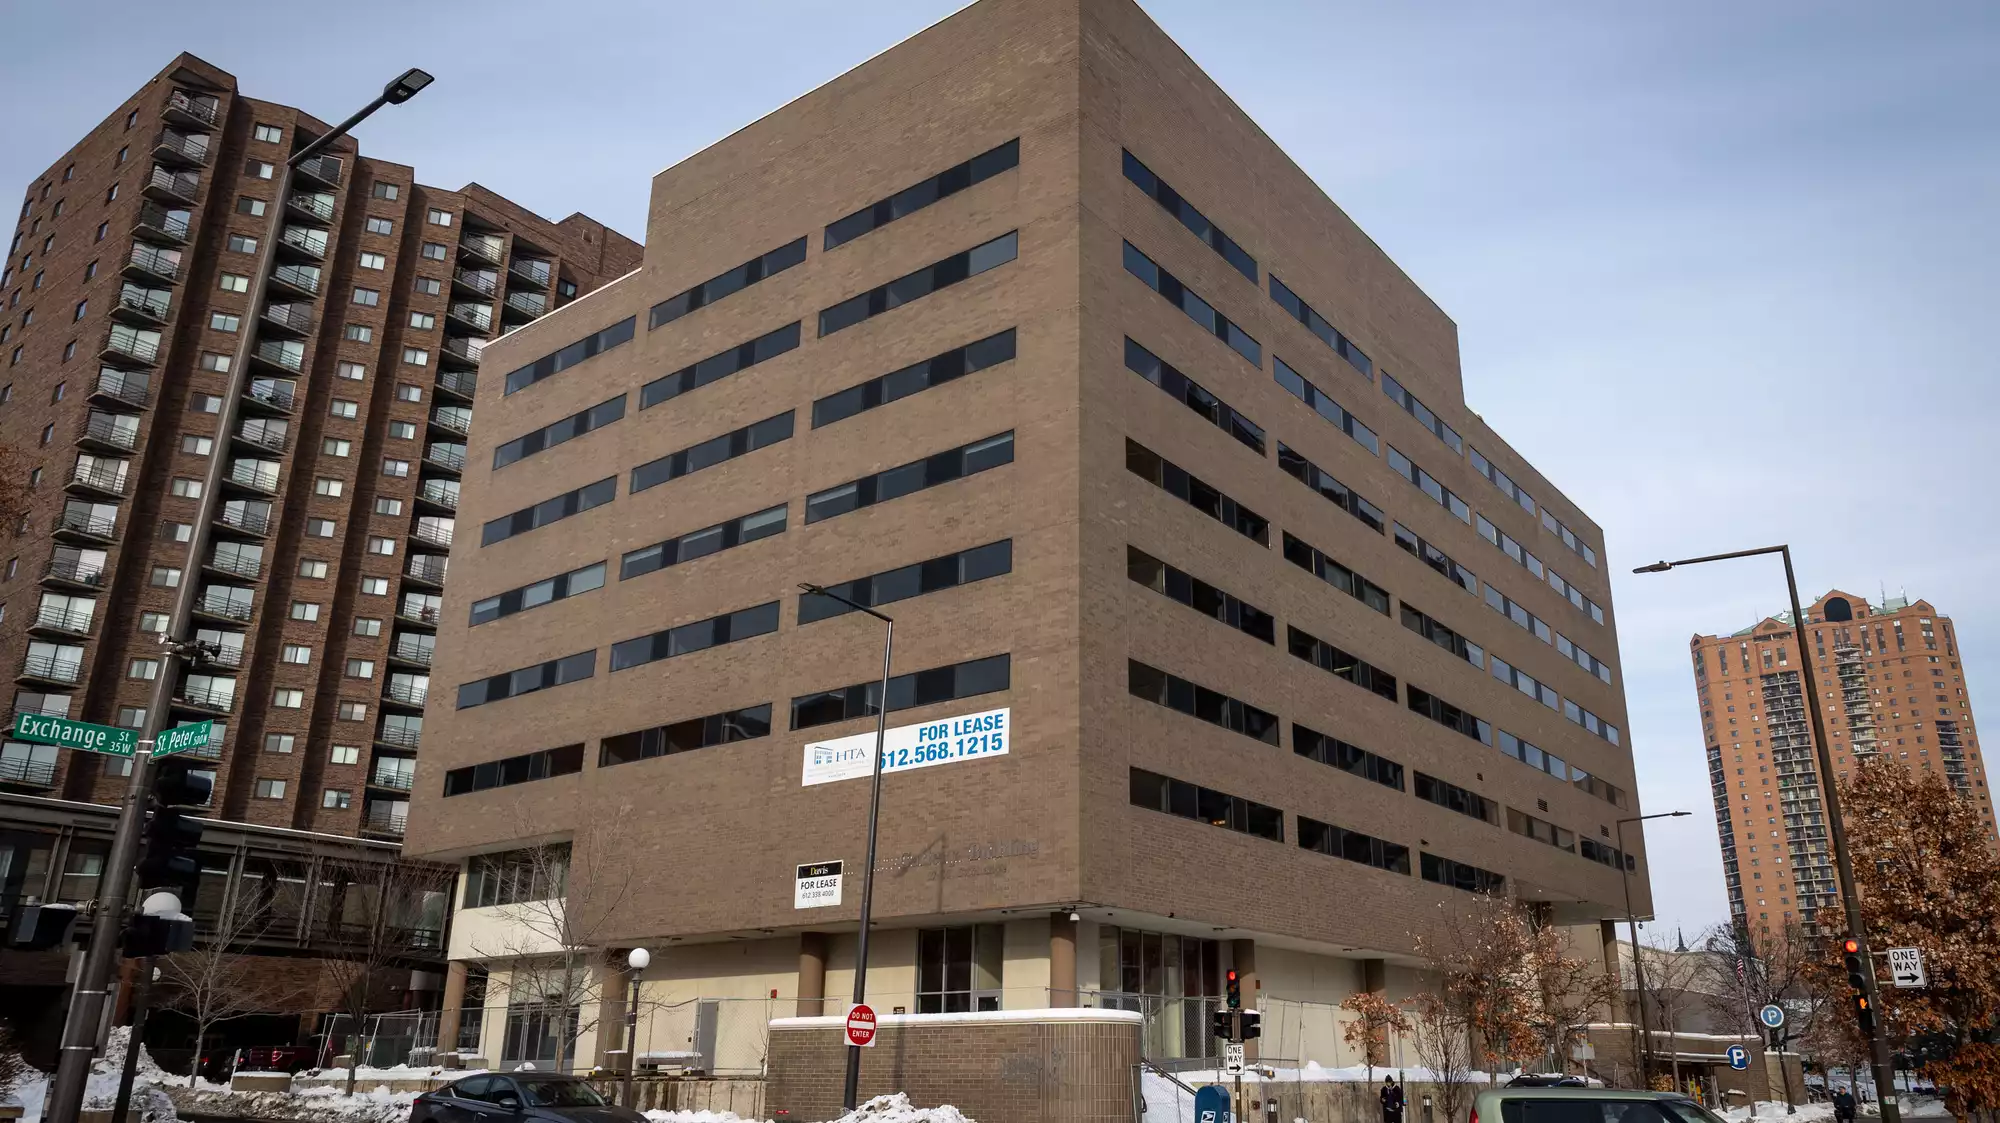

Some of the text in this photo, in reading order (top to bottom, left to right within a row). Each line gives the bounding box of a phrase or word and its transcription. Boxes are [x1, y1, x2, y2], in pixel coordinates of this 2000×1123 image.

[19, 715, 106, 749] Exchange
[919, 714, 1004, 742] FOR LEASE
[118, 731, 129, 742] St
[155, 730, 195, 752] St. Peter
[836, 748, 866, 762] HTA
[810, 866, 829, 875] Davis
[800, 878, 837, 890] FOR LEASE
[1892, 950, 1917, 960] ONE
[1893, 961, 1918, 971] WAY
[861, 1012, 873, 1020] NOT
[852, 1029, 870, 1038] ENTER
[1228, 1046, 1242, 1054] ONE
[1228, 1055, 1242, 1063] WAY
[1732, 1049, 1745, 1065] P
